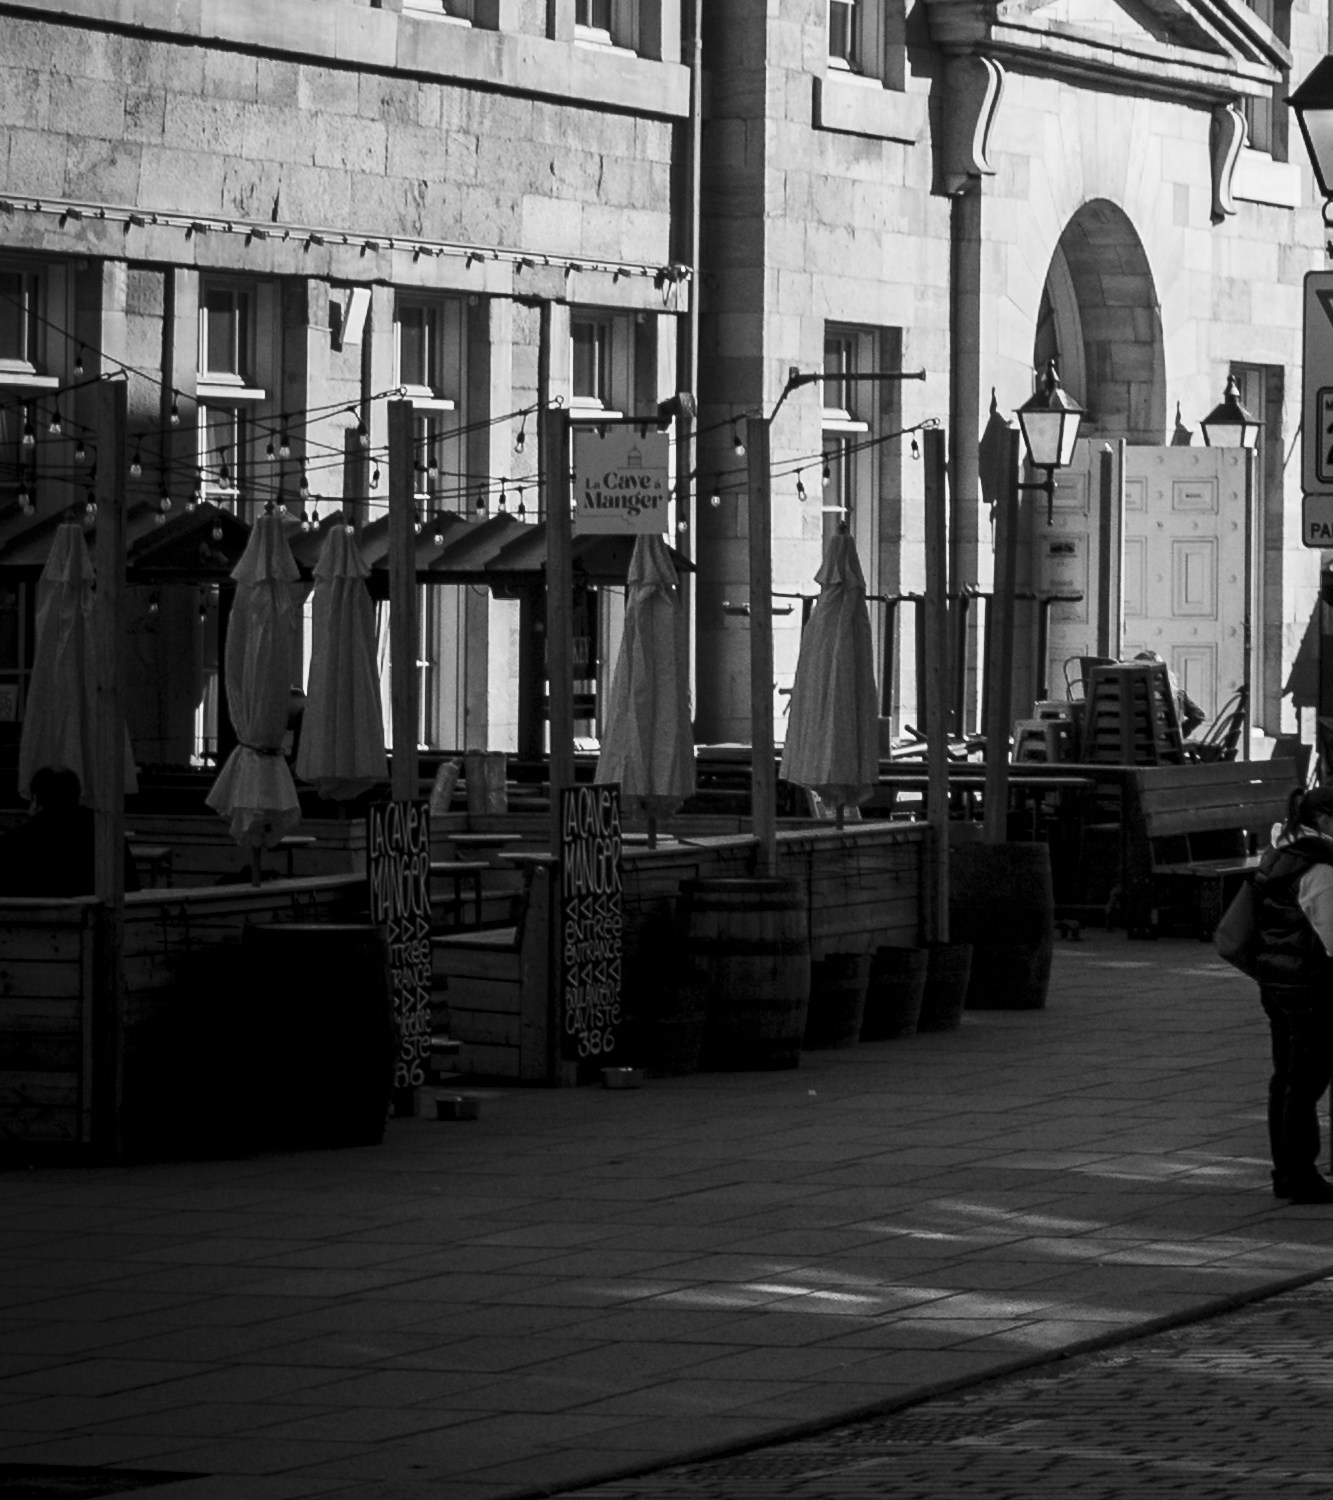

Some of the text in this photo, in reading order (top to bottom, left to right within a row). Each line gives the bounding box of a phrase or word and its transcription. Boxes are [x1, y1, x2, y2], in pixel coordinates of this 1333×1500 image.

[586, 478, 600, 490] La
[603, 472, 651, 490] Cave
[583, 491, 663, 516] Manger
[578, 1027, 615, 1057] 386
